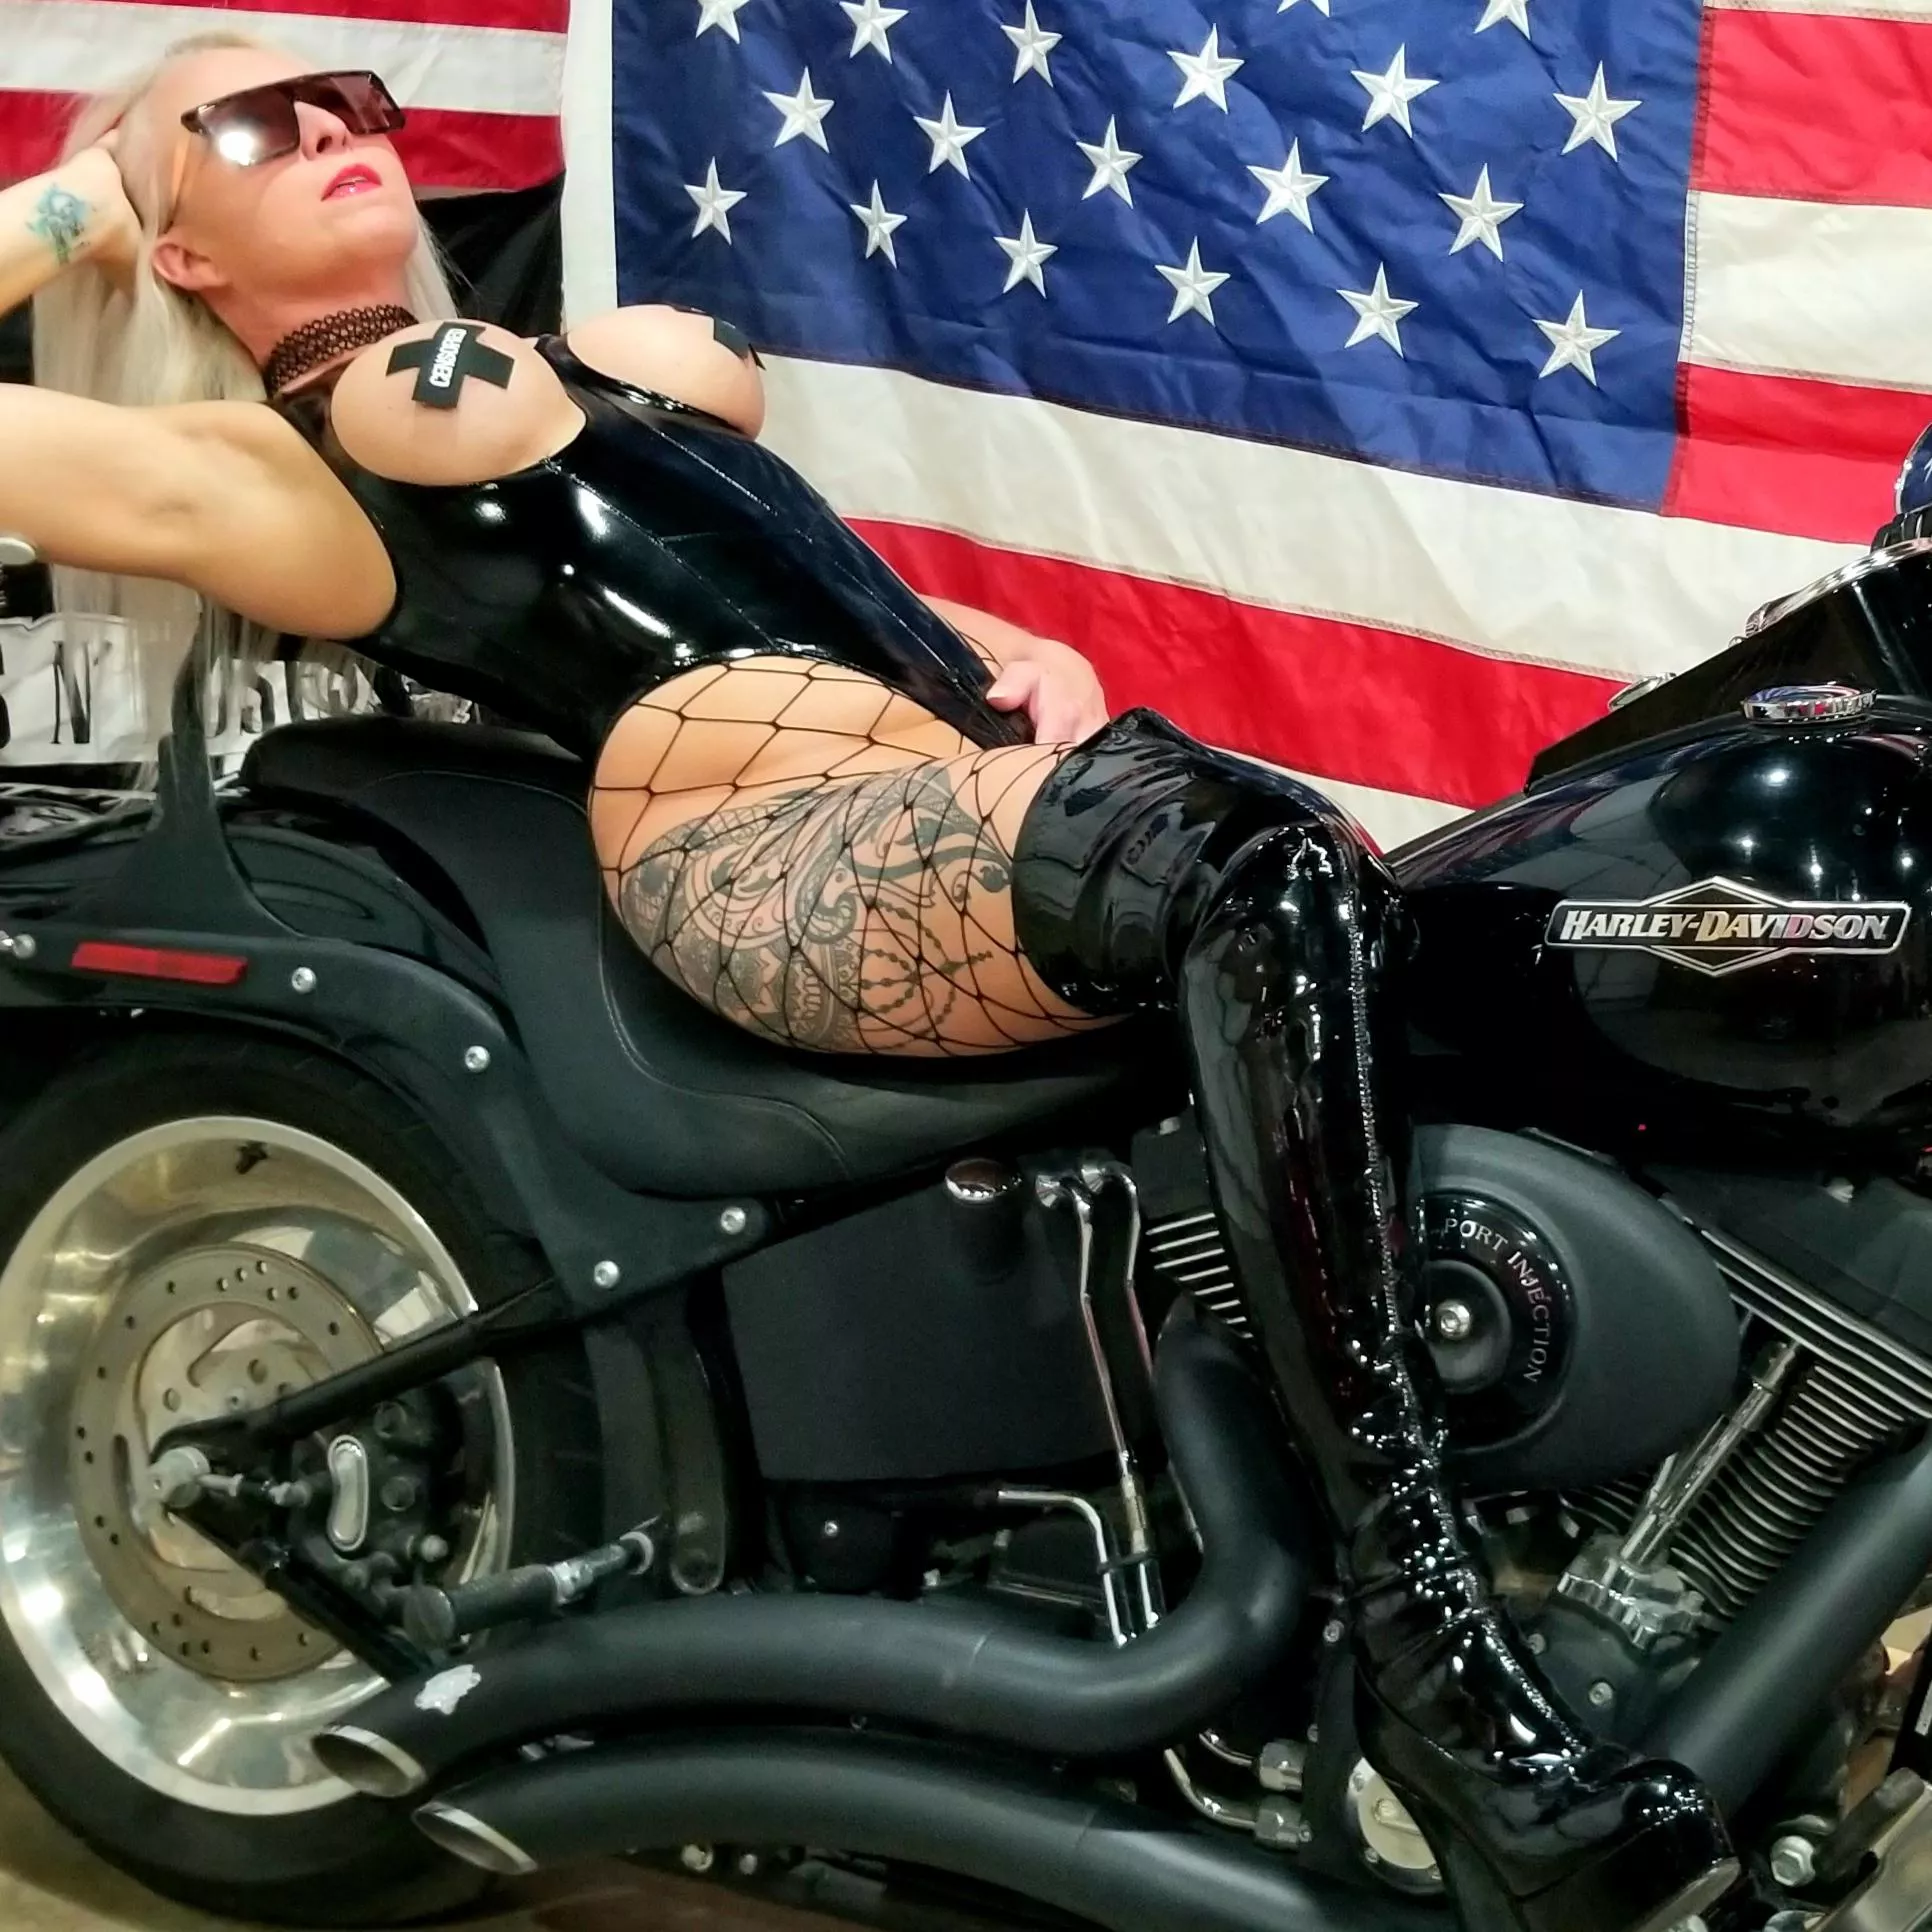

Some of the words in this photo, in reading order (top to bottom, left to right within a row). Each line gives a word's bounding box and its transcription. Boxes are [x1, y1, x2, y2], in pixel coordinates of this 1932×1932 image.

[1559, 909, 1888, 942] HARLEY-DAVIDSON
[1443, 1217, 1509, 1251] PORT
[1506, 1251, 1553, 1383] INJECTION
